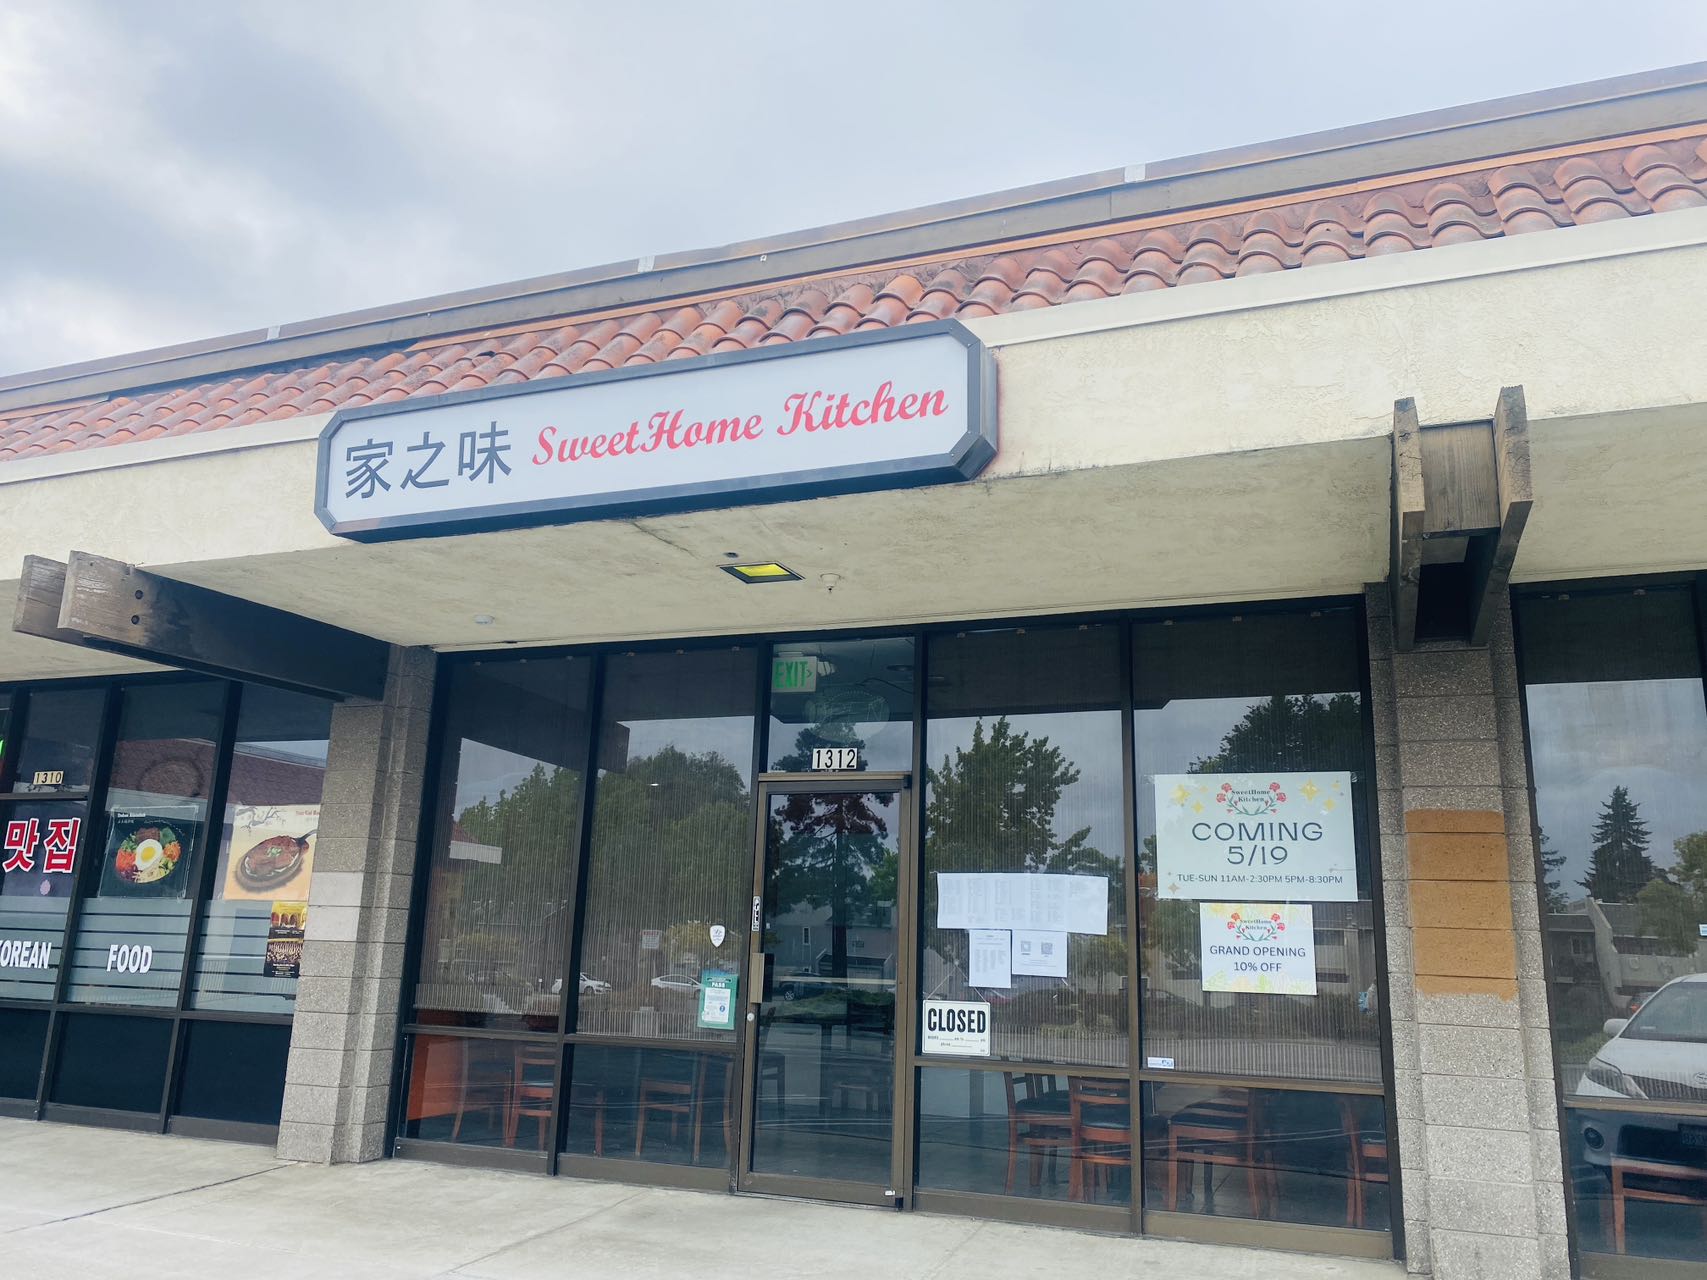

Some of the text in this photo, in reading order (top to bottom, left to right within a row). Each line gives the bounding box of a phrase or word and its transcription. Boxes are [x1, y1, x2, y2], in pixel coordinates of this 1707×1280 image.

[776, 380, 949, 436] Kitchen
[345, 421, 512, 499] 家之味
[773, 660, 809, 689] EXIT
[816, 749, 856, 769] 1312
[36, 772, 62, 784] 1310
[1191, 822, 1323, 841] COMING
[3, 818, 81, 874] 맛집
[1227, 845, 1288, 867] 5/19
[1177, 873, 1343, 885] TUE-SUN 11AM-2:30PM 5PM-8:30PM
[0, 940, 153, 973] OREAN FOOD
[1209, 945, 1306, 958] GRAND OPENING
[1233, 961, 1282, 972] 10% OFF
[927, 1007, 987, 1034] CLOSED
